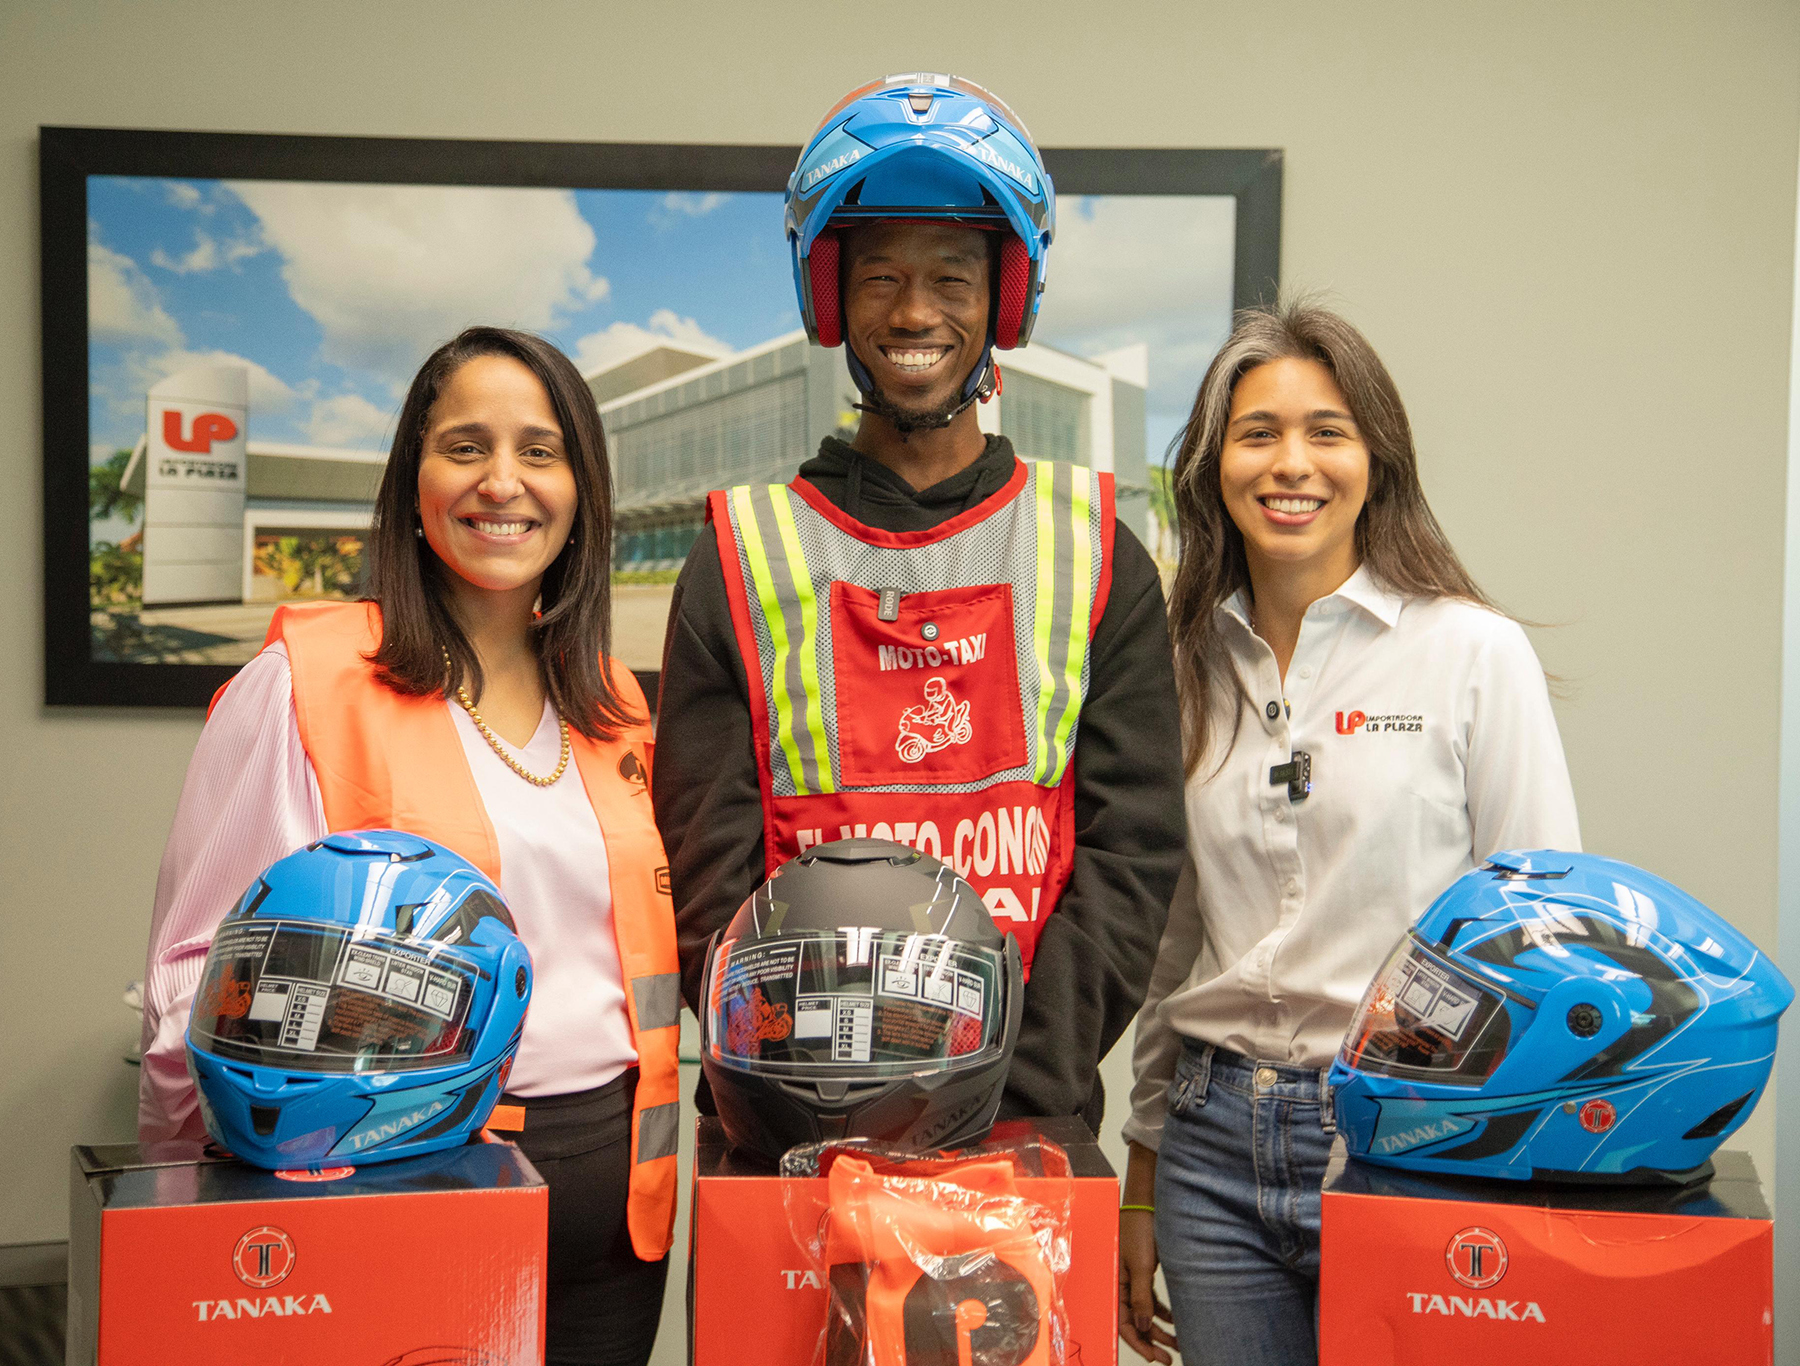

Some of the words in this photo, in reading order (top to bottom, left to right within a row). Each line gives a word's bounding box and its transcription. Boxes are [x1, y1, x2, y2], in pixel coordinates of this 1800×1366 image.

[805, 149, 861, 184] TANAKA
[978, 147, 1033, 188] TANAKA
[163, 410, 238, 453] LP
[878, 632, 987, 671] MOTO-TAXI
[1366, 714, 1423, 722] IMPORTADORA
[1366, 723, 1379, 732] LA
[1384, 722, 1423, 732] PLAZA
[389, 947, 431, 965] EXPORTER
[920, 953, 958, 968] EXPOER
[1421, 958, 1450, 981] EXPORTER
[349, 1101, 443, 1149] TANAKA
[1378, 1120, 1459, 1152] TANAKA
[192, 1293, 333, 1322] TANAKA
[1406, 1291, 1547, 1323] TANAKA
